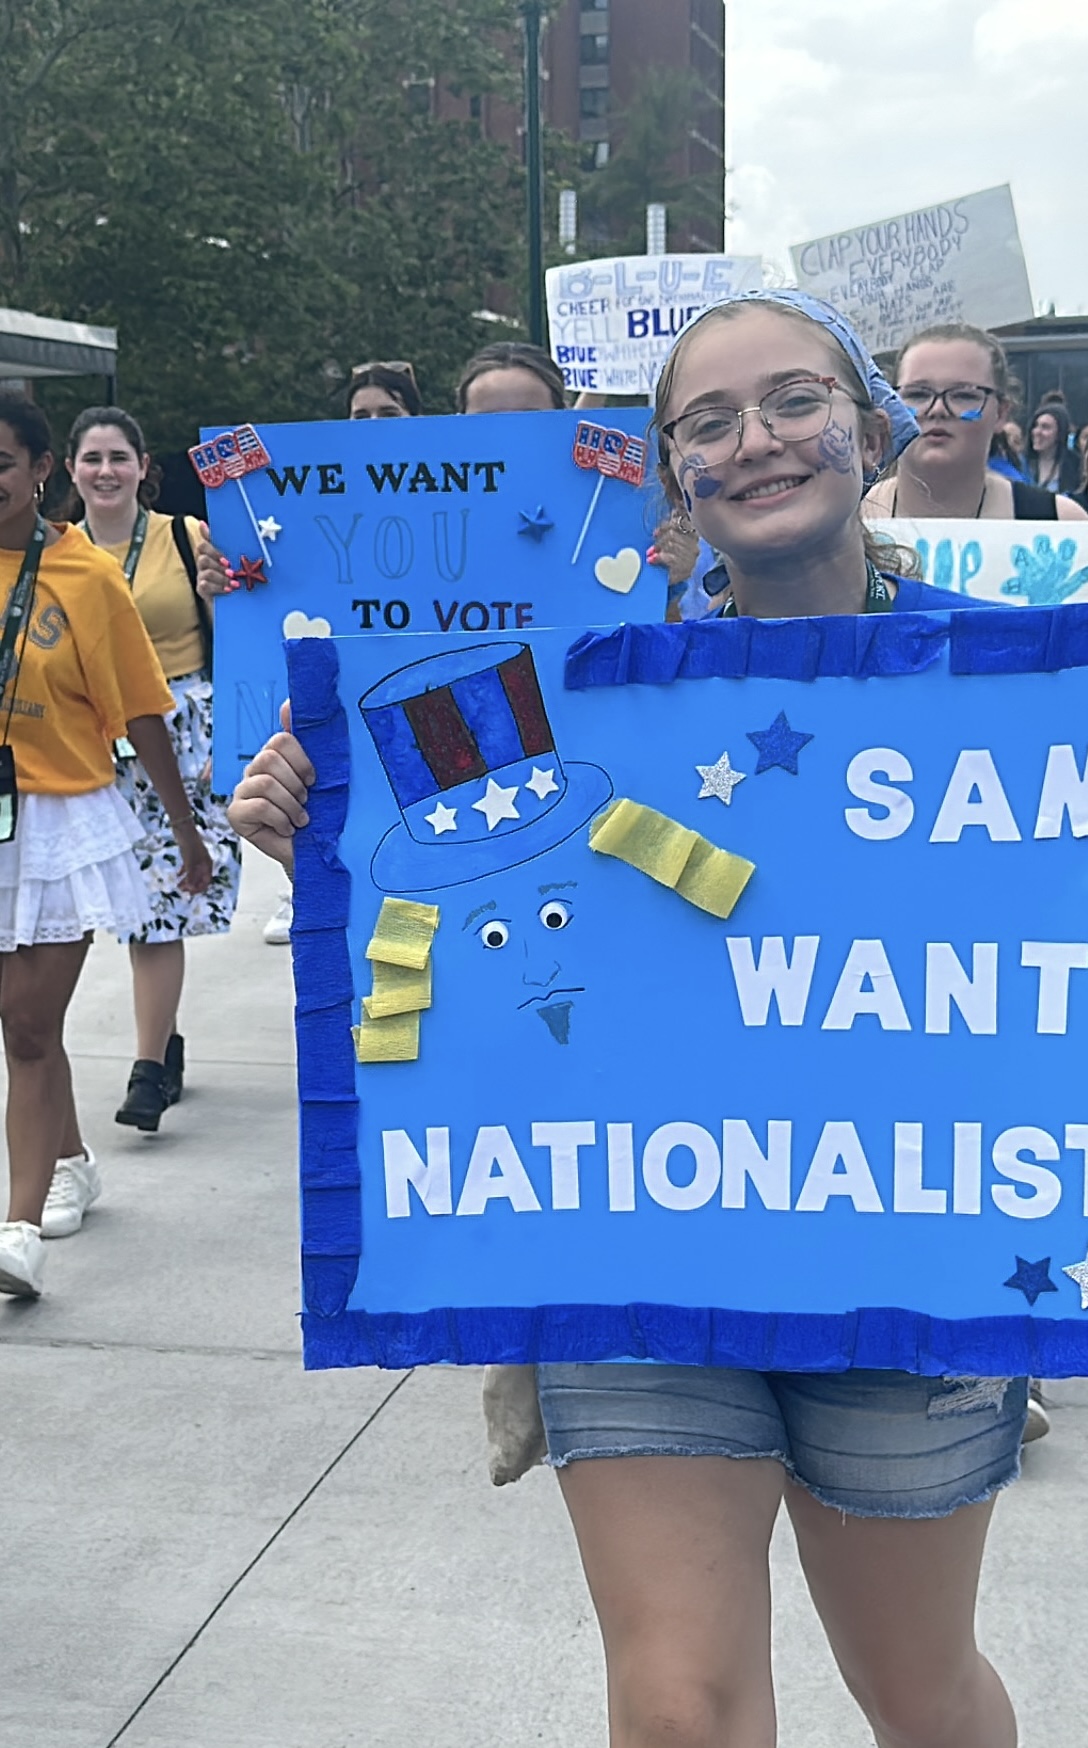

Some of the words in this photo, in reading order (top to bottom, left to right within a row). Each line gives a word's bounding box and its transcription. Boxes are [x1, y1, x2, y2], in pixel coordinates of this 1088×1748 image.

[857, 221, 899, 257] YOUR
[903, 201, 969, 246] HANDS
[849, 236, 962, 282] EVERYBODY
[556, 298, 612, 317] CHEER
[553, 316, 619, 344] YELL
[266, 463, 345, 497] WE
[366, 460, 505, 494] WANT
[313, 507, 473, 585] YOU
[351, 599, 411, 630] TO
